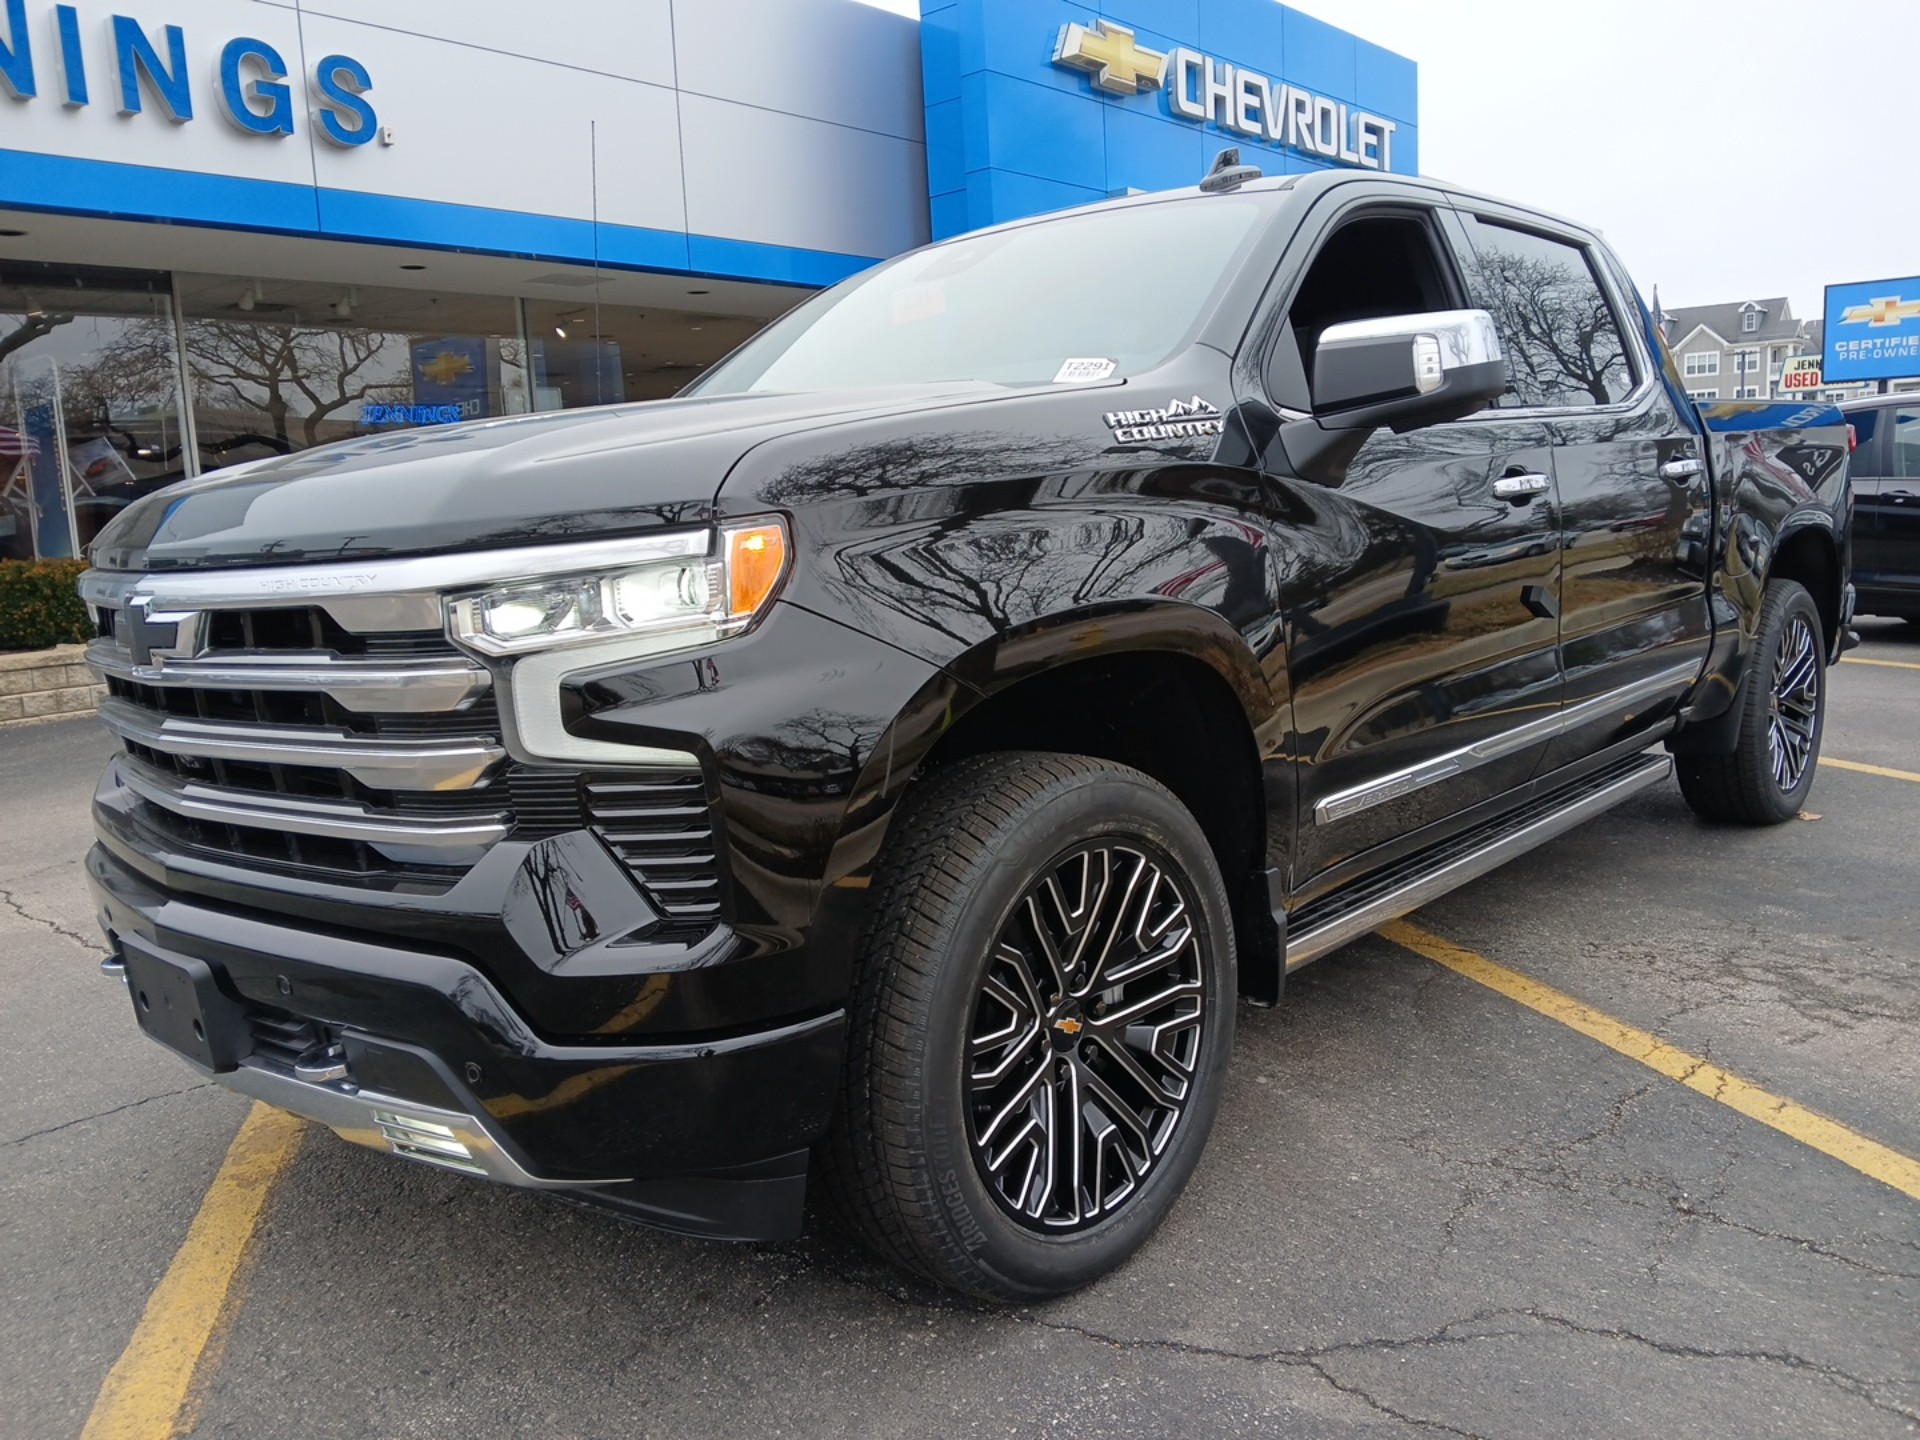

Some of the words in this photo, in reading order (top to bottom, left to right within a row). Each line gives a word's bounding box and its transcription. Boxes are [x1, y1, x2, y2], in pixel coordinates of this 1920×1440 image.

[1170, 47, 1396, 172] CHEVROLET
[1835, 335, 1919, 351] CERTIFIE
[1839, 346, 1918, 361] PRE-OWNE
[1066, 361, 1110, 371] T2291
[1784, 372, 1818, 388] USED
[362, 404, 460, 424] JENNINGS
[1103, 408, 1168, 428] HIGH
[1114, 420, 1224, 443] COUNTRY
[260, 579, 294, 591] HIGH
[300, 574, 377, 588] COUNTRY
